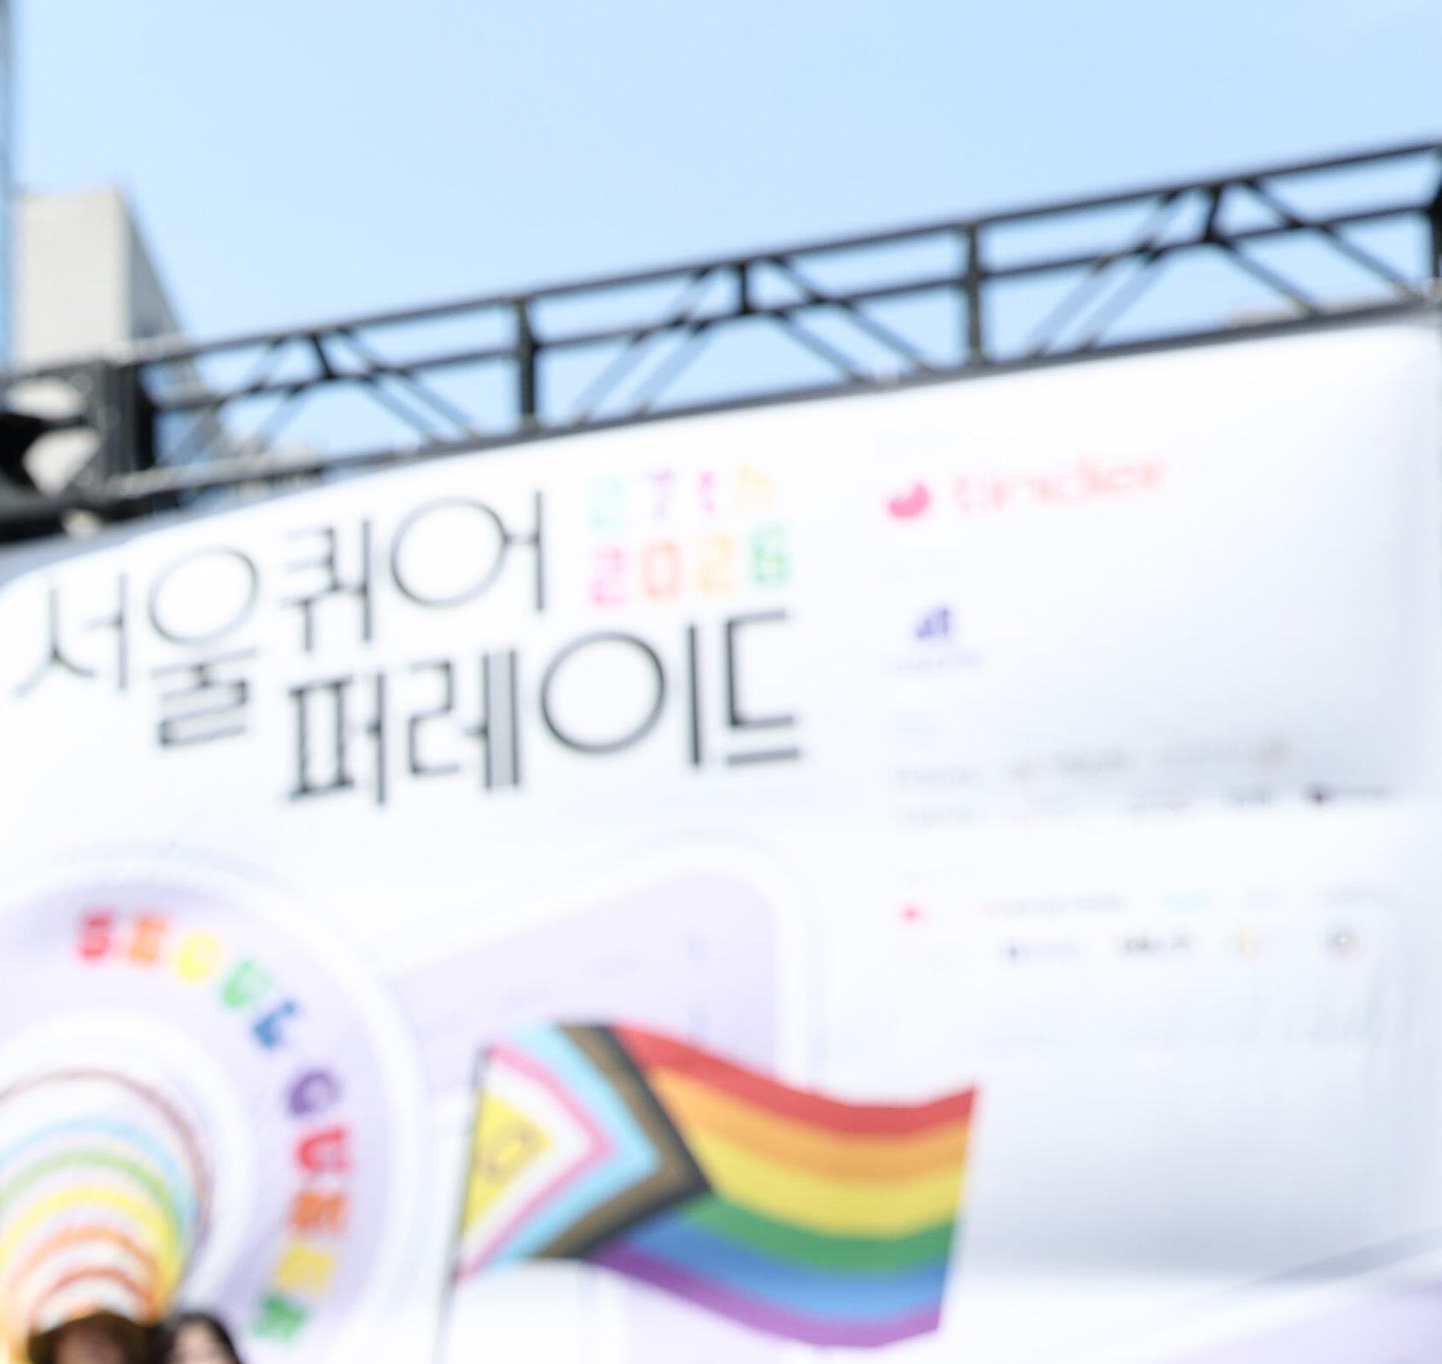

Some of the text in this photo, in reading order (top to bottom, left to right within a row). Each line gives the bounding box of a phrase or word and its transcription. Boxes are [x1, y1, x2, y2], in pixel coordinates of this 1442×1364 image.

[15, 490, 547, 748] 서울퀴어
[587, 522, 793, 608] 2026
[287, 609, 803, 806] 퍼레이드
